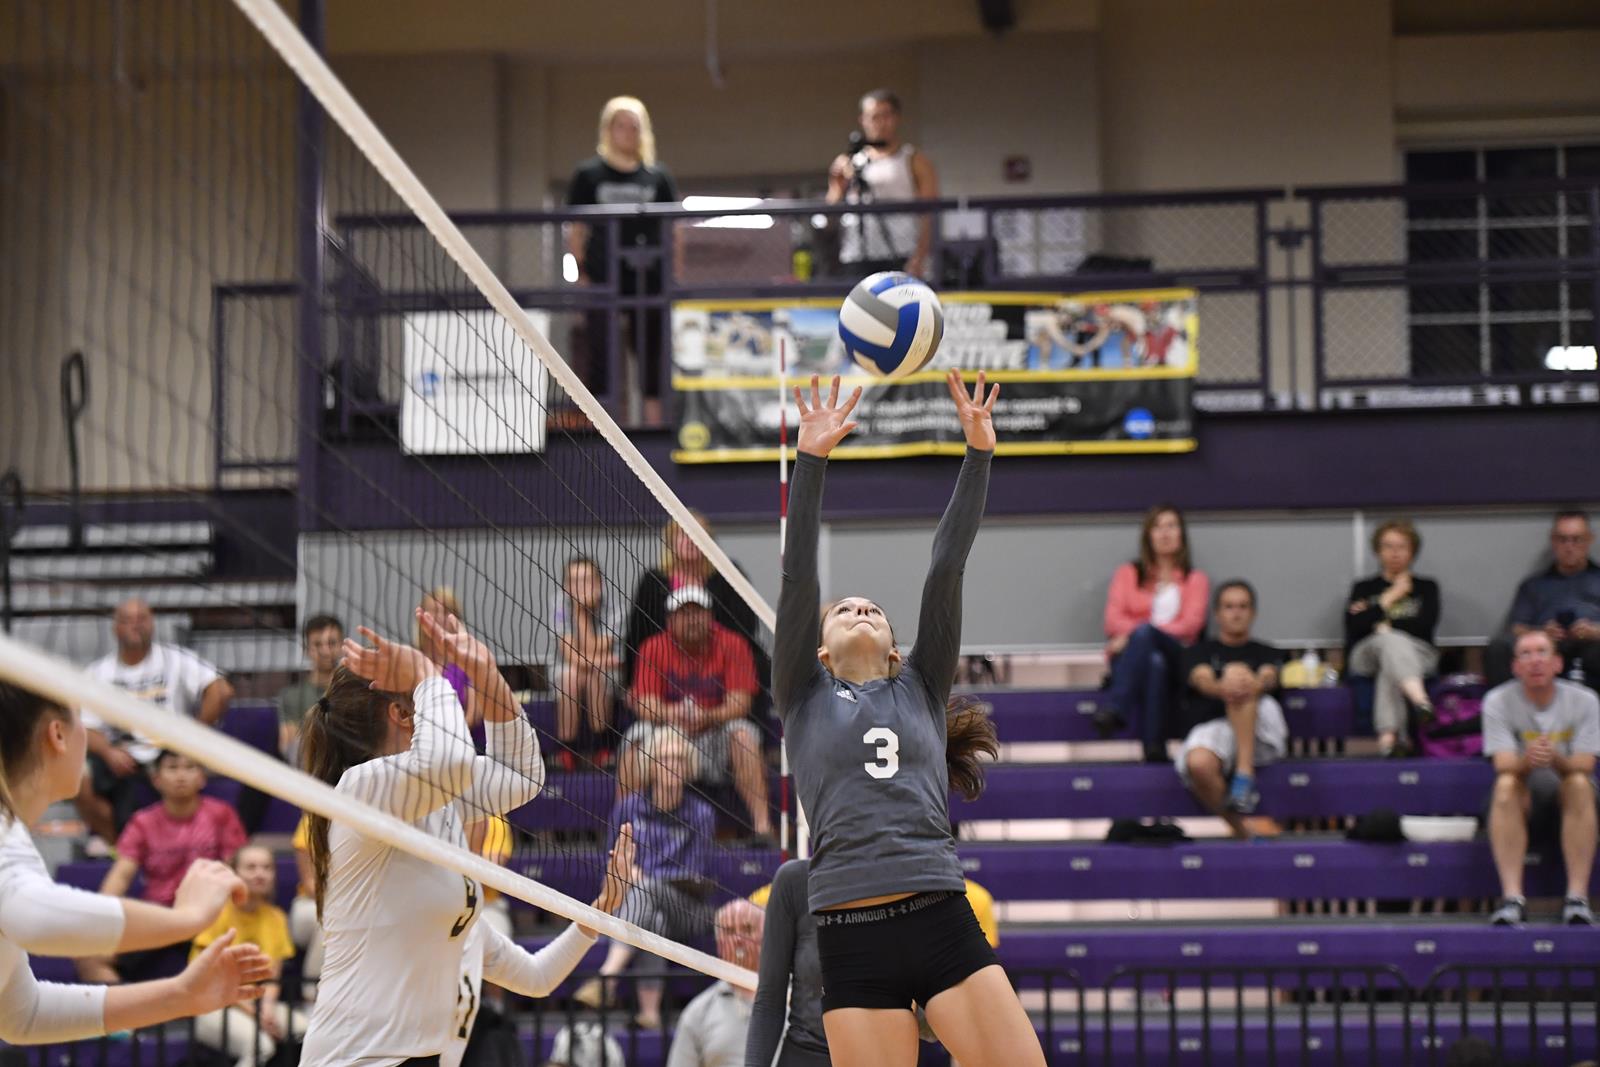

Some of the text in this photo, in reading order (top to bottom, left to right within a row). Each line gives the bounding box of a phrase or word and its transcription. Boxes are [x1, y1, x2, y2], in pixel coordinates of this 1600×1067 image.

[863, 727, 899, 779] 3
[844, 909, 887, 924] ARMOUR
[909, 892, 949, 913] ARMOUR
